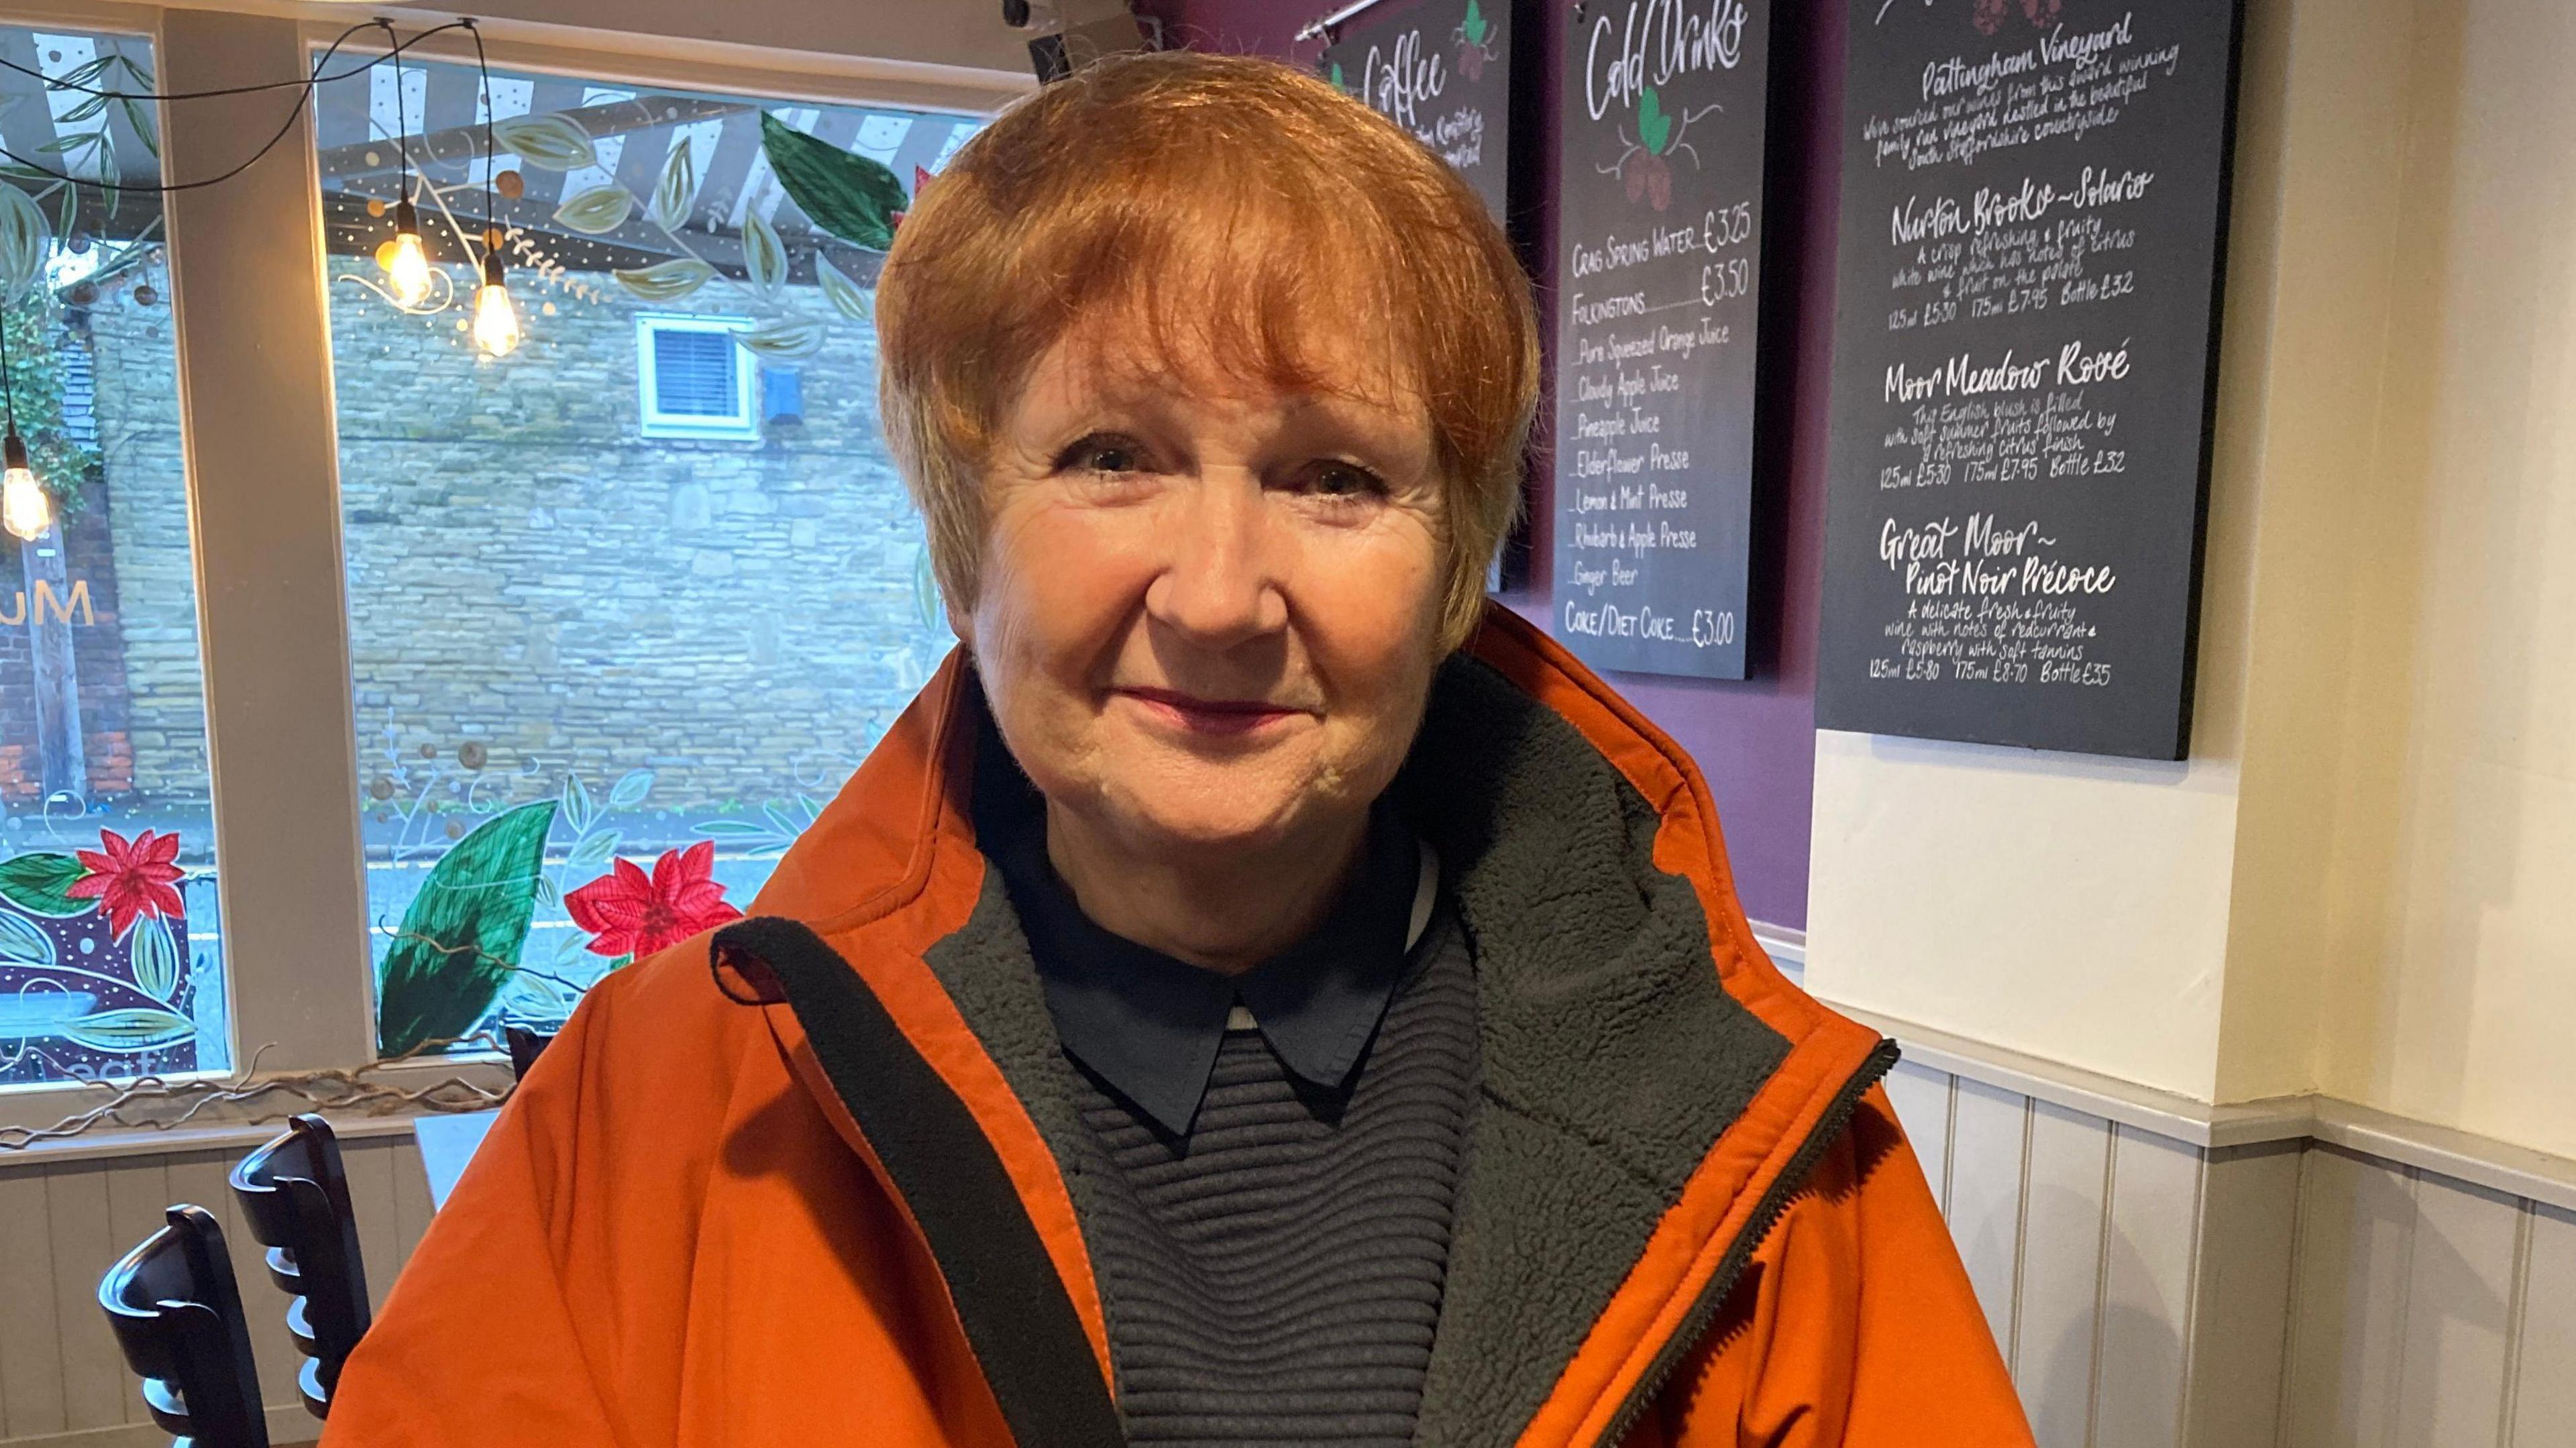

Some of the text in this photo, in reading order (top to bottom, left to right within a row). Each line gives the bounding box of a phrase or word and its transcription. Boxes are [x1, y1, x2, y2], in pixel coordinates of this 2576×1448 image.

[1586, 0, 1748, 120] Cold Drinks
[1923, 11, 2132, 102] Pattingham Vineyard
[2006, 82, 2036, 113] from
[2040, 75, 2064, 95] this
[2070, 54, 2112, 87] award
[2119, 43, 2179, 76] winning
[1364, 30, 1446, 129] Coffee
[1876, 133, 1911, 168] family
[1917, 127, 1938, 146] run
[1943, 108, 1998, 141] vineyard
[2002, 95, 2048, 125] nestled
[2070, 90, 2086, 109] the
[2090, 70, 2147, 105] beautiful
[1909, 104, 2119, 170] South Staffordshire countryside
[1892, 195, 1970, 245] Nurton
[2074, 166, 2154, 209] Solaris
[1652, 225, 1696, 258] WATER
[1892, 266, 1921, 289] white
[1927, 264, 1955, 282] wine
[2000, 249, 2022, 270] has
[2029, 244, 2063, 263] notes
[2091, 229, 2135, 252] citrus
[1917, 245, 1926, 264] A
[1931, 242, 1962, 266] crisp
[1970, 229, 2039, 259] refreshing
[2057, 215, 2102, 249] fruity
[1701, 258, 1749, 307] £3.50
[1888, 309, 1917, 331] 125ml
[1972, 296, 2004, 318] 175ml
[2061, 278, 2099, 306] Bottle
[2100, 270, 2134, 300] £32
[1956, 272, 1990, 302] fruit
[1992, 274, 2012, 290] on
[2015, 268, 2037, 286] the
[2041, 258, 2084, 289] palate
[1607, 329, 1655, 369] Squeezed
[1659, 325, 1696, 359] Orange
[1699, 317, 1729, 345] Juice
[1578, 366, 1679, 410] Cloudy Apple Juice
[1885, 336, 2131, 402] Moor Meadow Rosé
[1578, 406, 1660, 446] Pineapple Juice
[1913, 389, 2084, 427] This English blush is filled
[1885, 410, 2117, 451] with soft summer fruits followed by
[1934, 440, 1994, 467] refreshing
[1999, 437, 2037, 457] citrus
[2042, 433, 2085, 459] finish
[1578, 442, 1690, 483] Elderflower Presse
[1880, 465, 1912, 490] 125ml
[1964, 461, 1998, 482] 175ml
[2000, 457, 2039, 482] £7.95
[2049, 451, 2090, 478] Bottle
[2094, 449, 2125, 475] £32
[1576, 488, 1608, 515] Lemon
[1621, 484, 1644, 510] Mint
[1649, 483, 1688, 509] Presse
[1576, 522, 1617, 551] Rhubarb
[1628, 521, 1656, 559] Apple
[1660, 520, 1697, 549] Presse
[1880, 516, 1958, 571] Great
[1964, 511, 2039, 557] Moor
[1574, 558, 1639, 596] Ginger Beer
[1906, 556, 2116, 596] Pinot Noir Précoce
[1640, 606, 1674, 641] COKE
[1693, 609, 1734, 648] £3.00
[1885, 620, 1914, 637] wine
[1921, 620, 1951, 637] with
[1953, 620, 1987, 638] notes
[1994, 621, 2006, 645] of
[2012, 621, 2087, 640] redcurrant
[1907, 599, 1917, 619] A
[1921, 599, 1973, 620] delicate
[1976, 596, 2023, 624] fresh
[2032, 599, 2076, 626] fruity
[1870, 657, 2112, 686] 125ml £5.80 175ml £8.70 Bottle £35
[1901, 638, 2084, 665] raspberry with soft tannins
